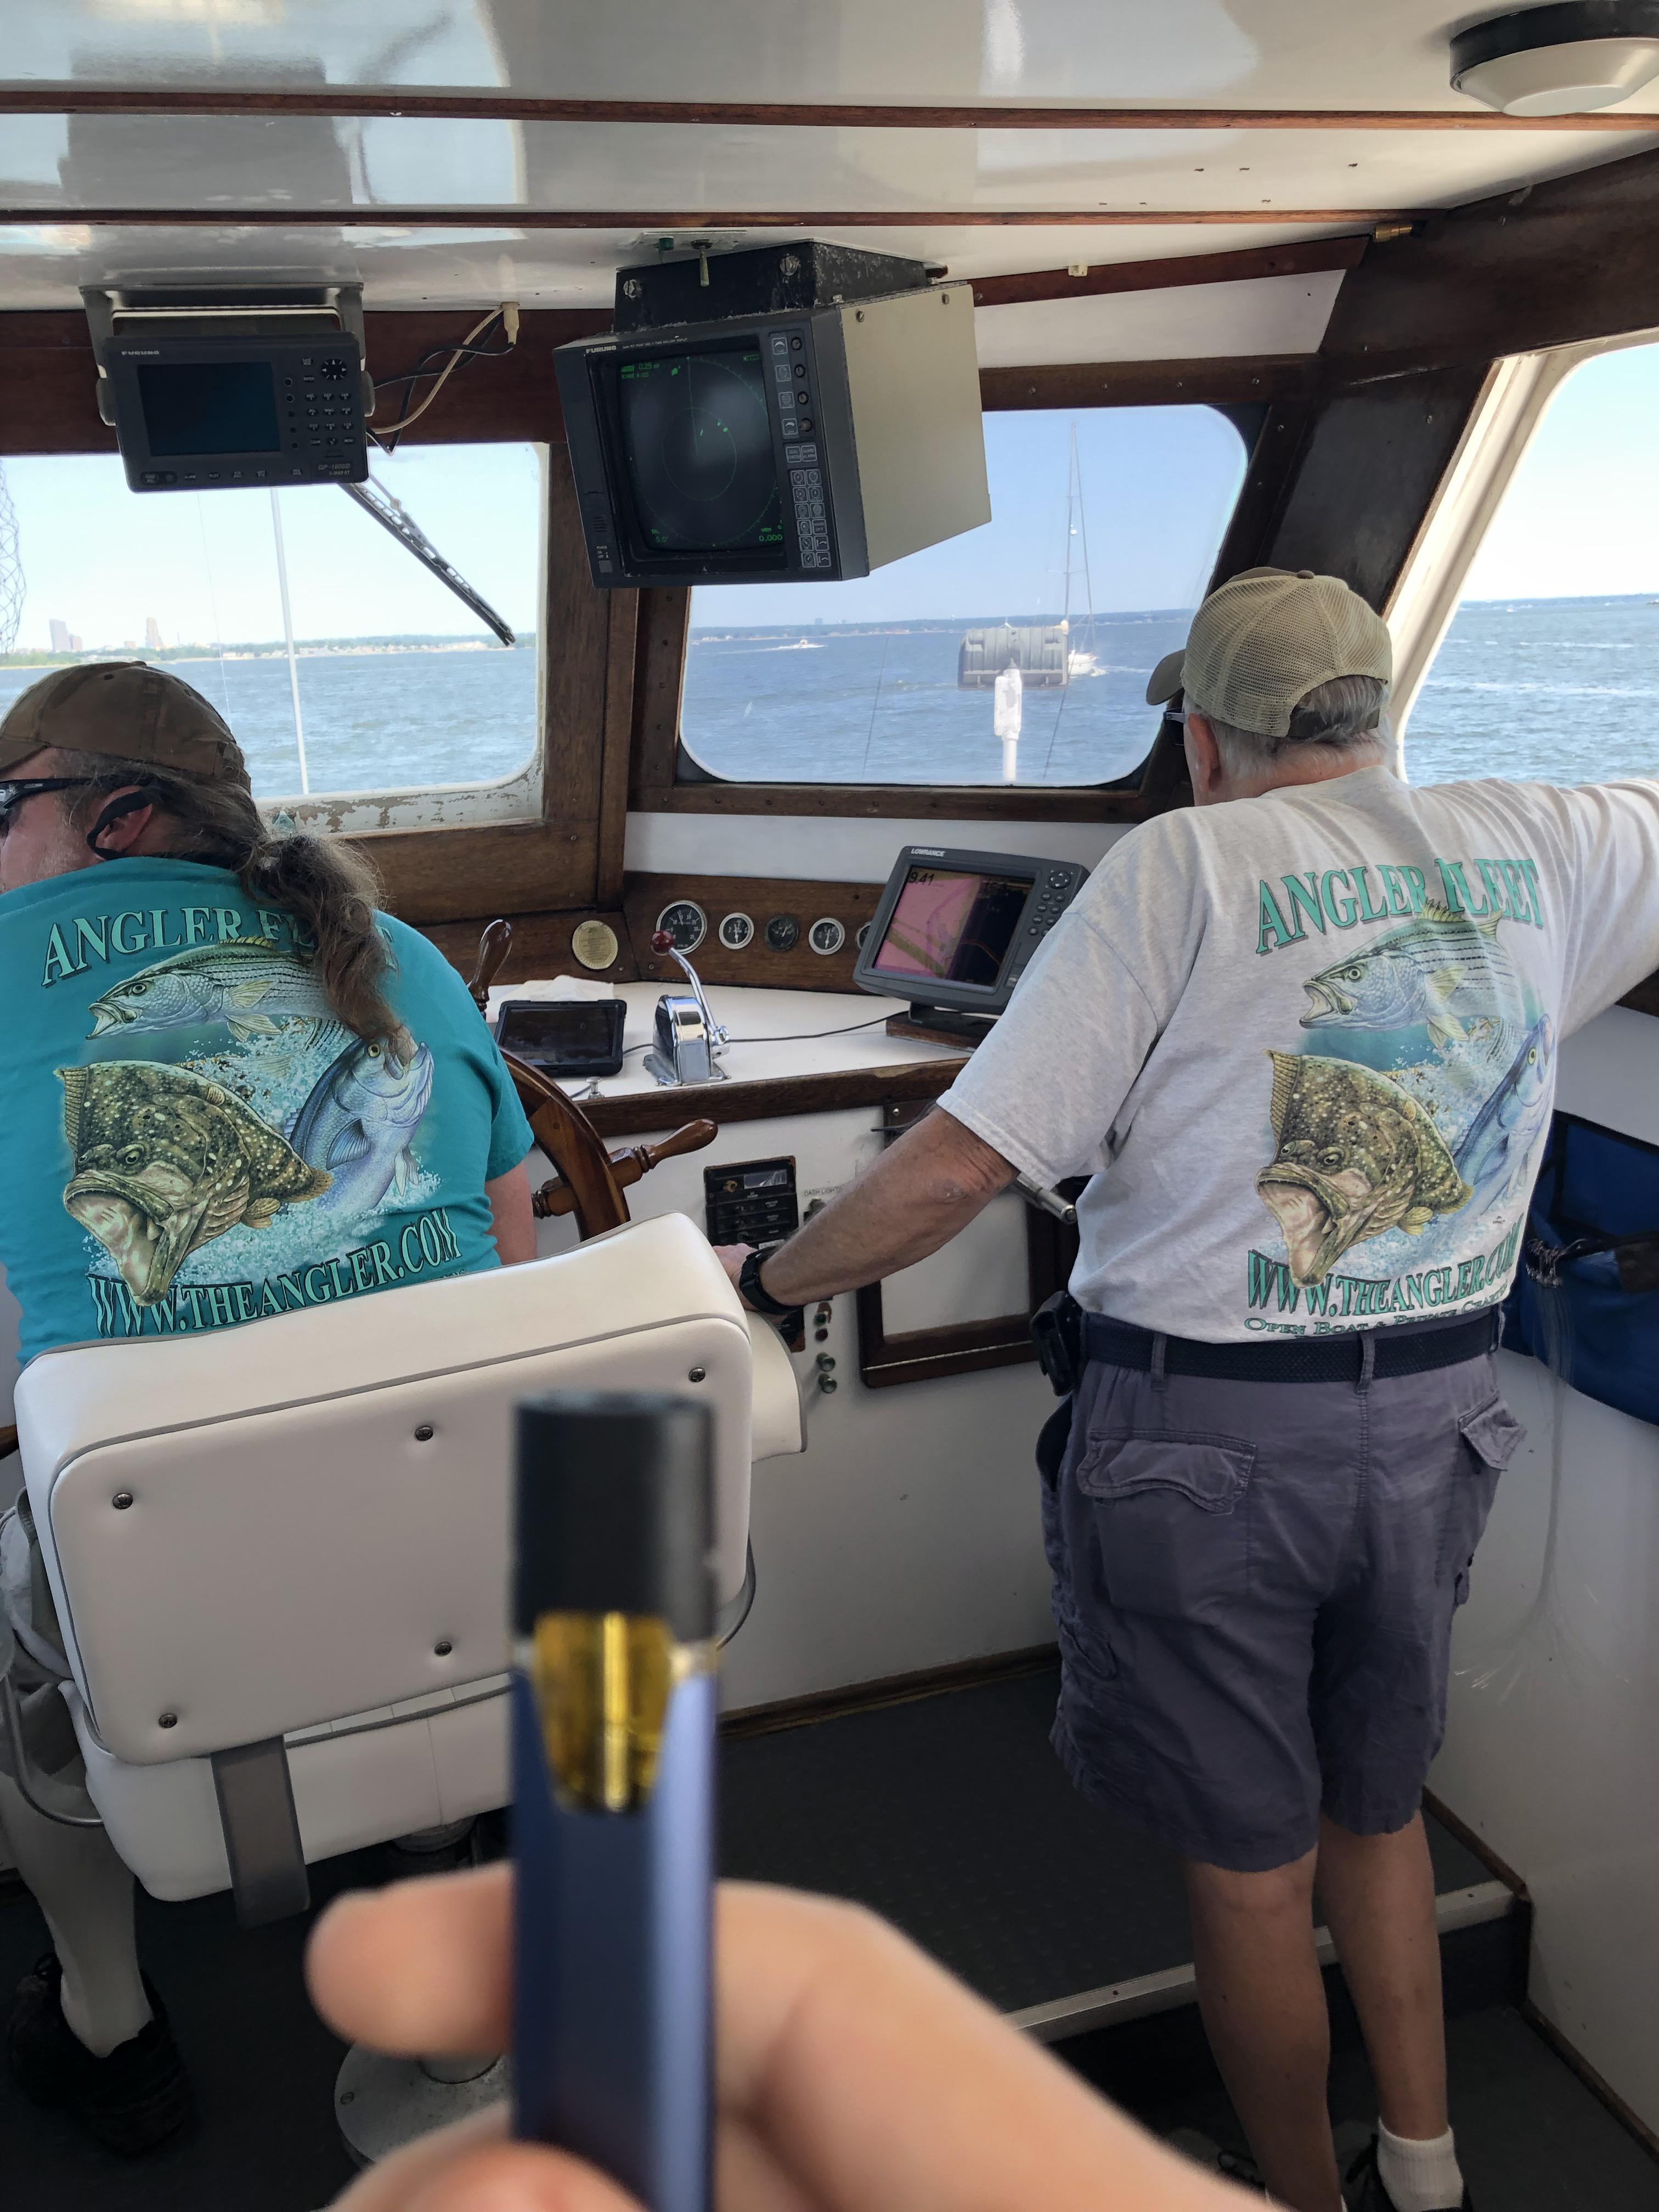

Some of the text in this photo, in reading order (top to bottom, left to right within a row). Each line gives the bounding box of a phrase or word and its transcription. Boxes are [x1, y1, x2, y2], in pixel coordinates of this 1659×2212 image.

[585, 345, 617, 354] FURUNO
[911, 848, 946, 857] LOWRANCE
[1255, 865, 1427, 956] ANGLER
[41, 906, 243, 988] ANGLER
[87, 1207, 462, 1337] WWW.THEANGLER.COM
[1244, 1318, 1306, 1335] OPEN
[1313, 1321, 1368, 1334] BOAT
